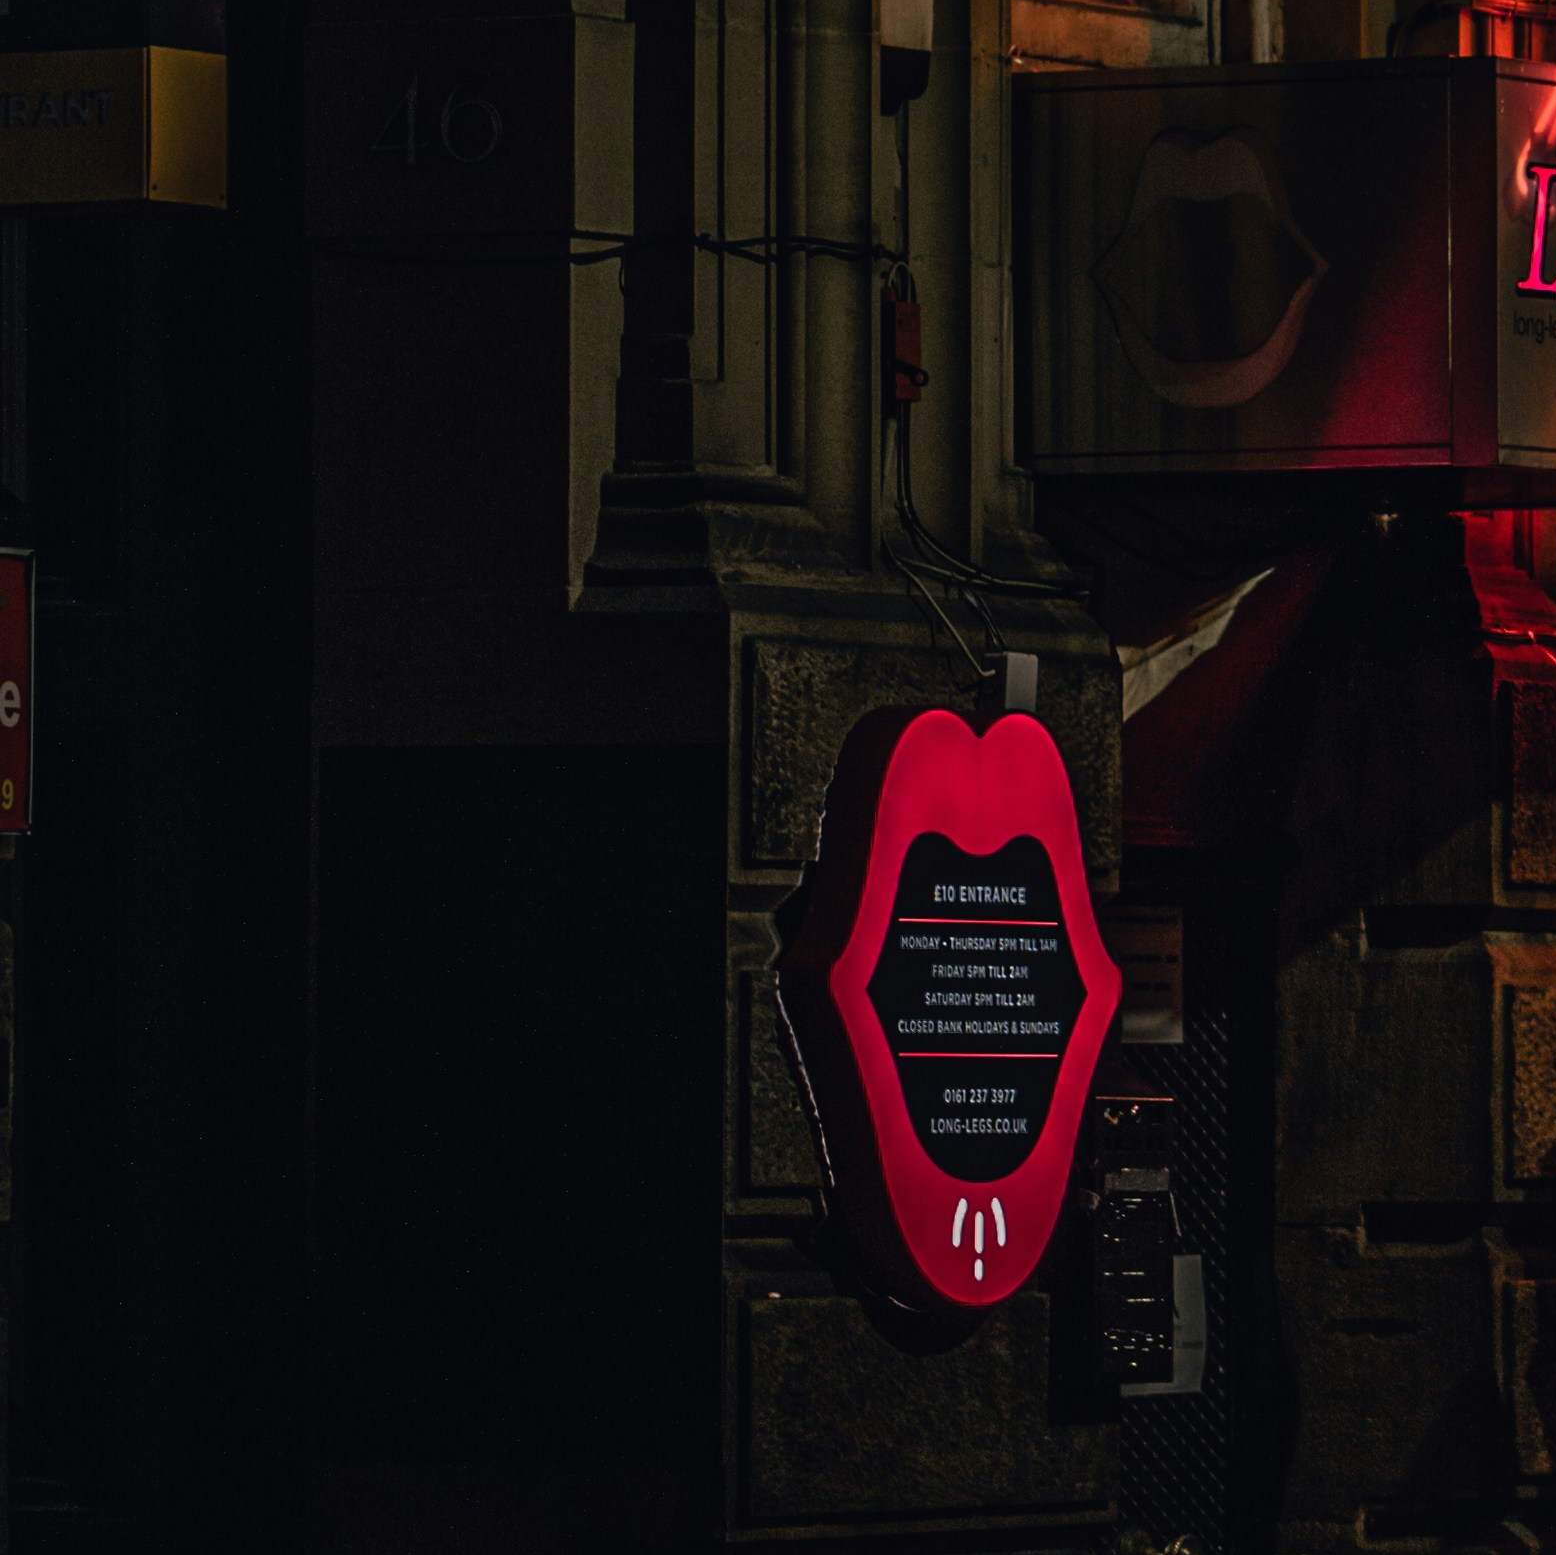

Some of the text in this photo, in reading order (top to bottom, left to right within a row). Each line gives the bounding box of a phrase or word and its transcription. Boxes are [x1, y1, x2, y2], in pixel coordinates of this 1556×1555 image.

[369, 74, 505, 165] 46
[934, 883, 1027, 906] £10 ENTRANCE
[900, 935, 941, 951] MONDAY
[949, 935, 997, 951] THURSDAY
[999, 936, 1018, 952] 5PM
[1018, 937, 1038, 953] TILL
[931, 963, 1029, 980] FRIDAY 5PM TILL 2AM
[923, 991, 1036, 1008] SATURDAY 5PM TILL 2AM
[897, 1018, 1061, 1036] CLOSED BANK HOLIDAYS & SUNDAYS
[944, 1087, 1017, 1105] 0161 237 3977
[930, 1117, 1029, 1135] LONG-LEGS.CO.UK
